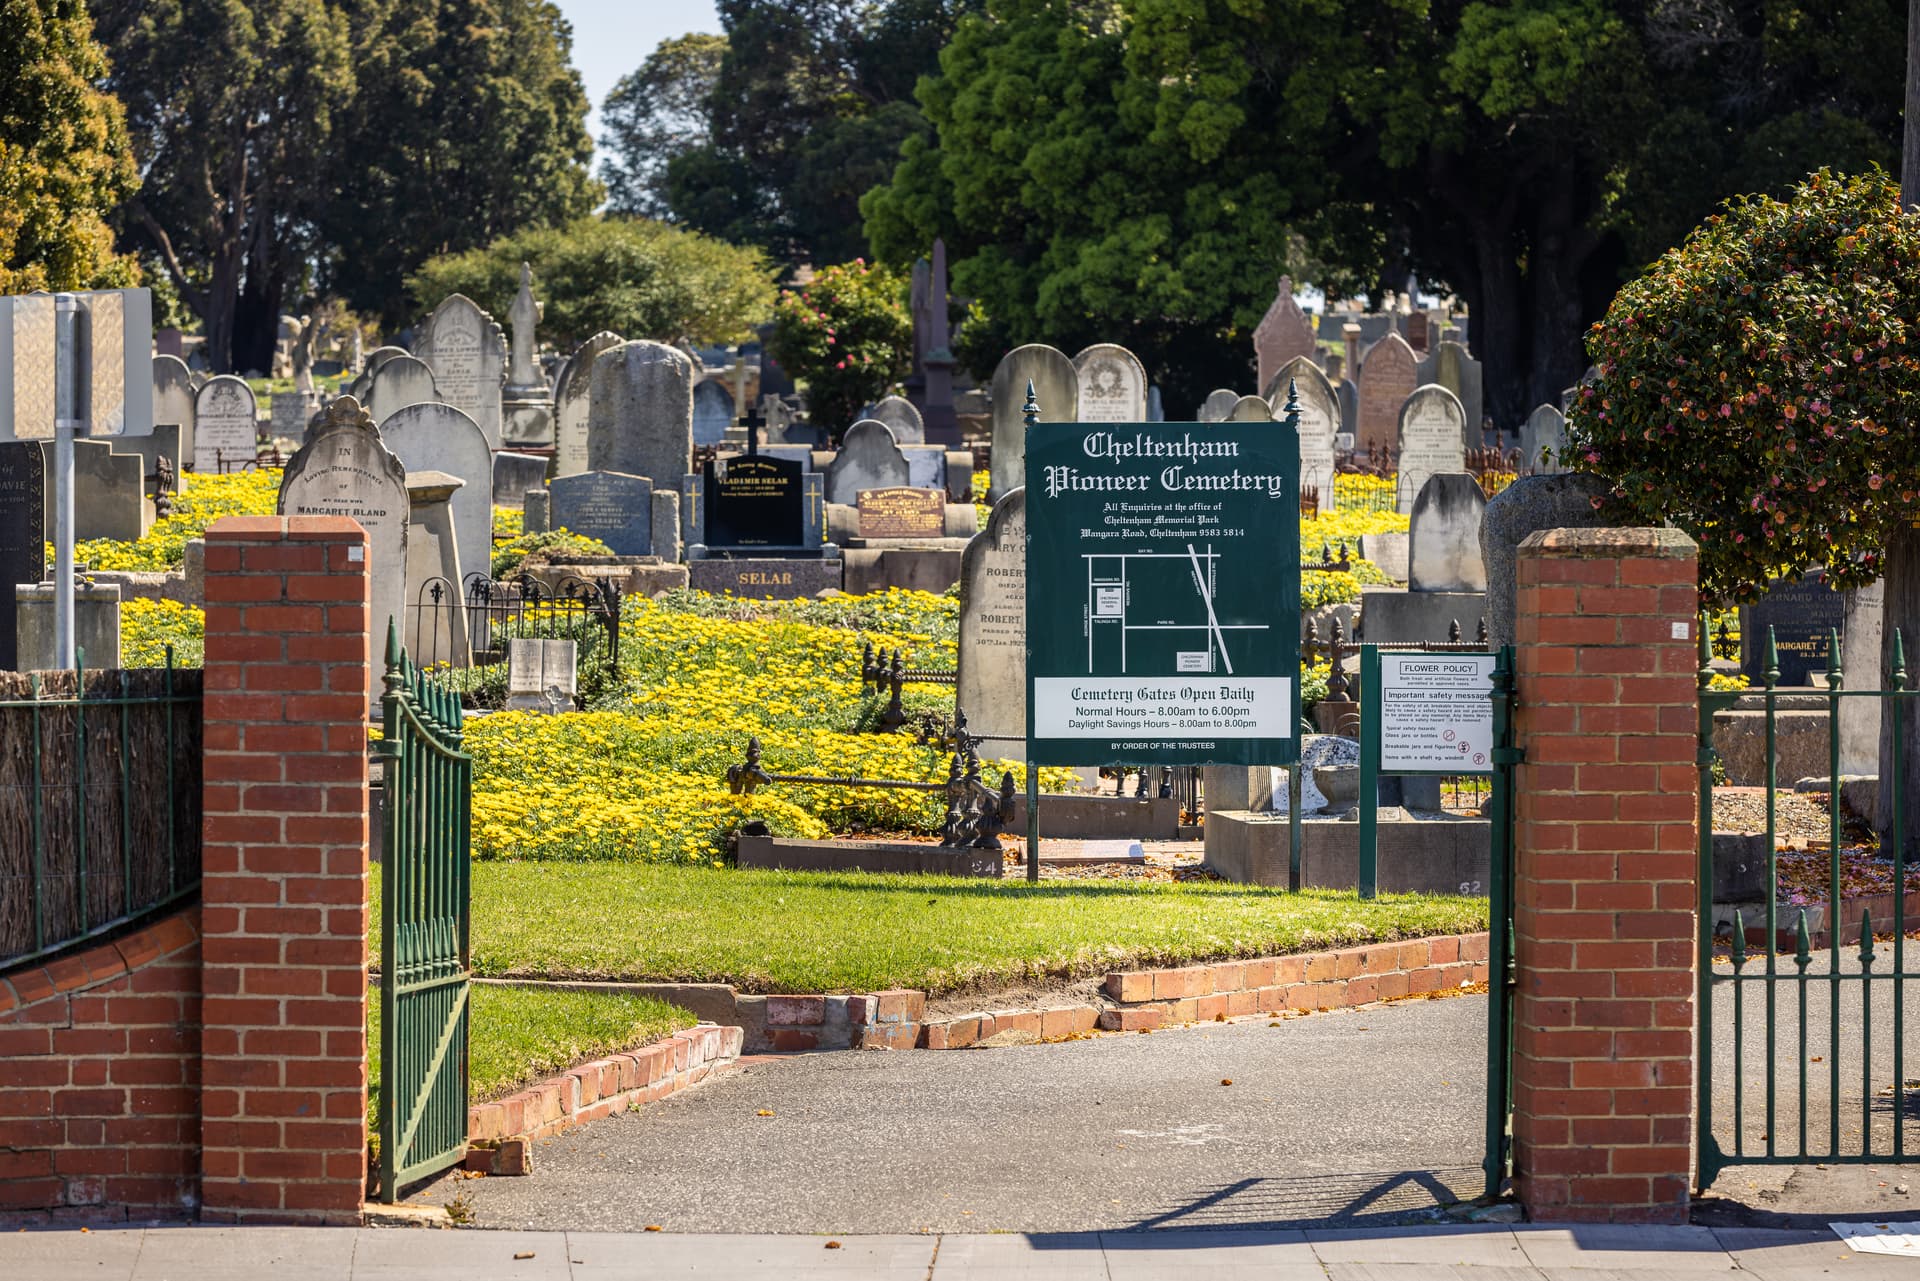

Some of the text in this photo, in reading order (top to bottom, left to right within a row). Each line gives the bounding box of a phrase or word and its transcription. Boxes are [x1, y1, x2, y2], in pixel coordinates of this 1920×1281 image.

[338, 447, 351, 456] IN
[1083, 432, 1239, 464] Cheltenham
[1043, 465, 1282, 498] Pioneer Cemetery
[297, 506, 387, 517] MARGARET BLAND
[1103, 502, 1222, 512] All Enquiries at the office of
[1104, 515, 1219, 525] Cheltenham Memorial Park
[1080, 529, 1244, 538] Wangara Road, Cheltenham 9583 5814
[739, 572, 792, 585] SELAR
[980, 615, 1021, 624] ROBERT
[1404, 665, 1473, 673] FLOWER POLICY
[1071, 687, 1254, 703] Cemetery Gates Open Daily
[1388, 691, 1424, 699] Important
[1428, 692, 1453, 700] safety
[1076, 706, 1113, 717] Normal
[1116, 706, 1147, 717] Hours
[1158, 706, 1196, 717] 8.00am
[1198, 706, 1209, 717] to
[1211, 706, 1250, 719] 6.00pm
[1068, 719, 1104, 730] Daylight
[1106, 719, 1141, 730] Savings
[1143, 719, 1170, 728] Hours
[1179, 719, 1212, 728] 8.00am
[1213, 719, 1222, 728] to
[1224, 719, 1257, 730] 8.00pm
[1111, 742, 1216, 750] BY ORDER OF THE TRUSTEES
[1459, 880, 1481, 895] 62
